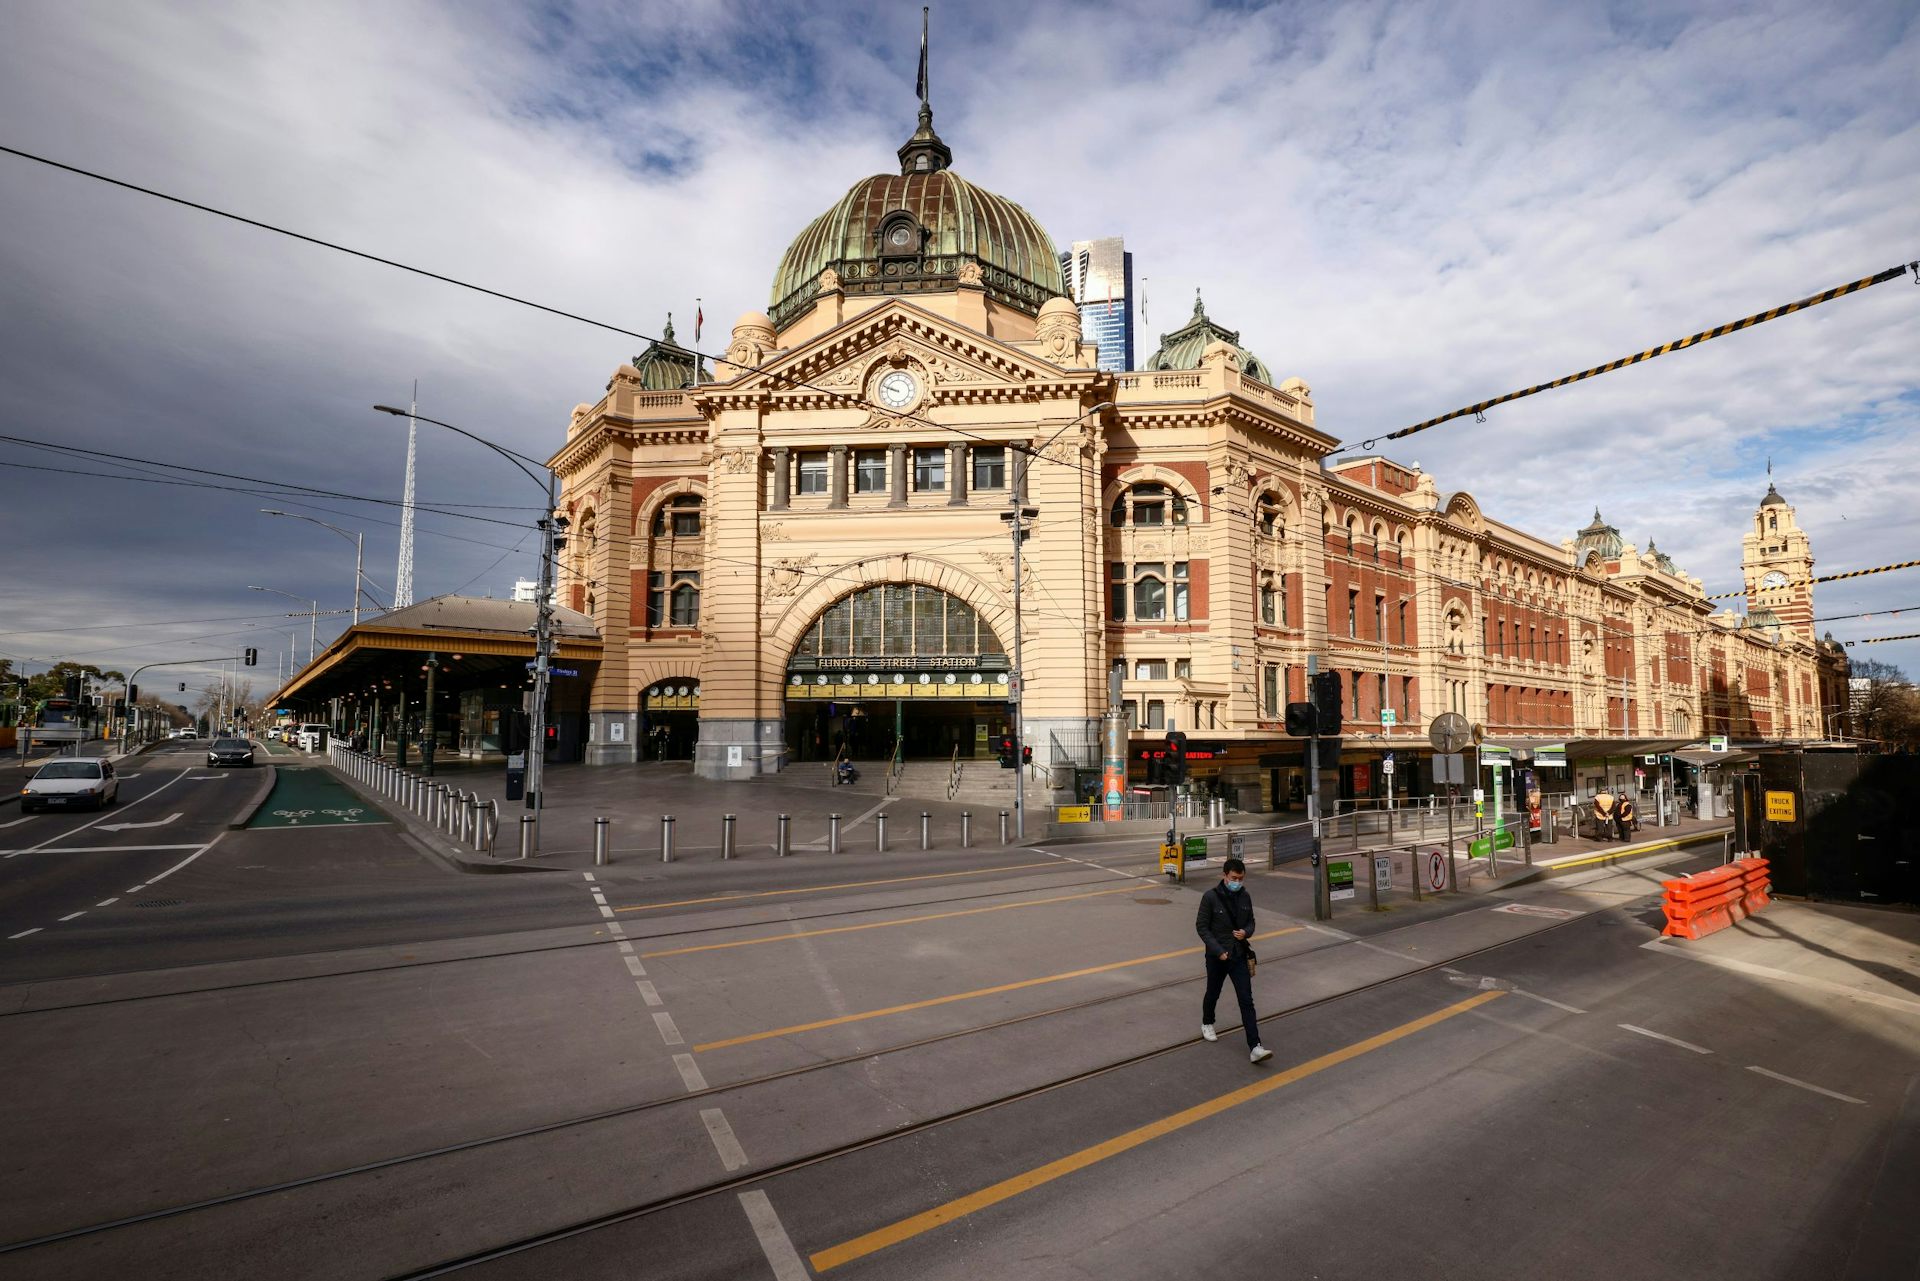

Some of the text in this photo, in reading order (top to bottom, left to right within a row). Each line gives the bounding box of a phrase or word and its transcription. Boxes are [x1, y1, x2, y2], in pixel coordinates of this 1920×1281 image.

[818, 658, 976, 667] FLINDERS STREET STATION
[1377, 860, 1388, 868] WATCH
[1378, 879, 1389, 888] TRAMS
